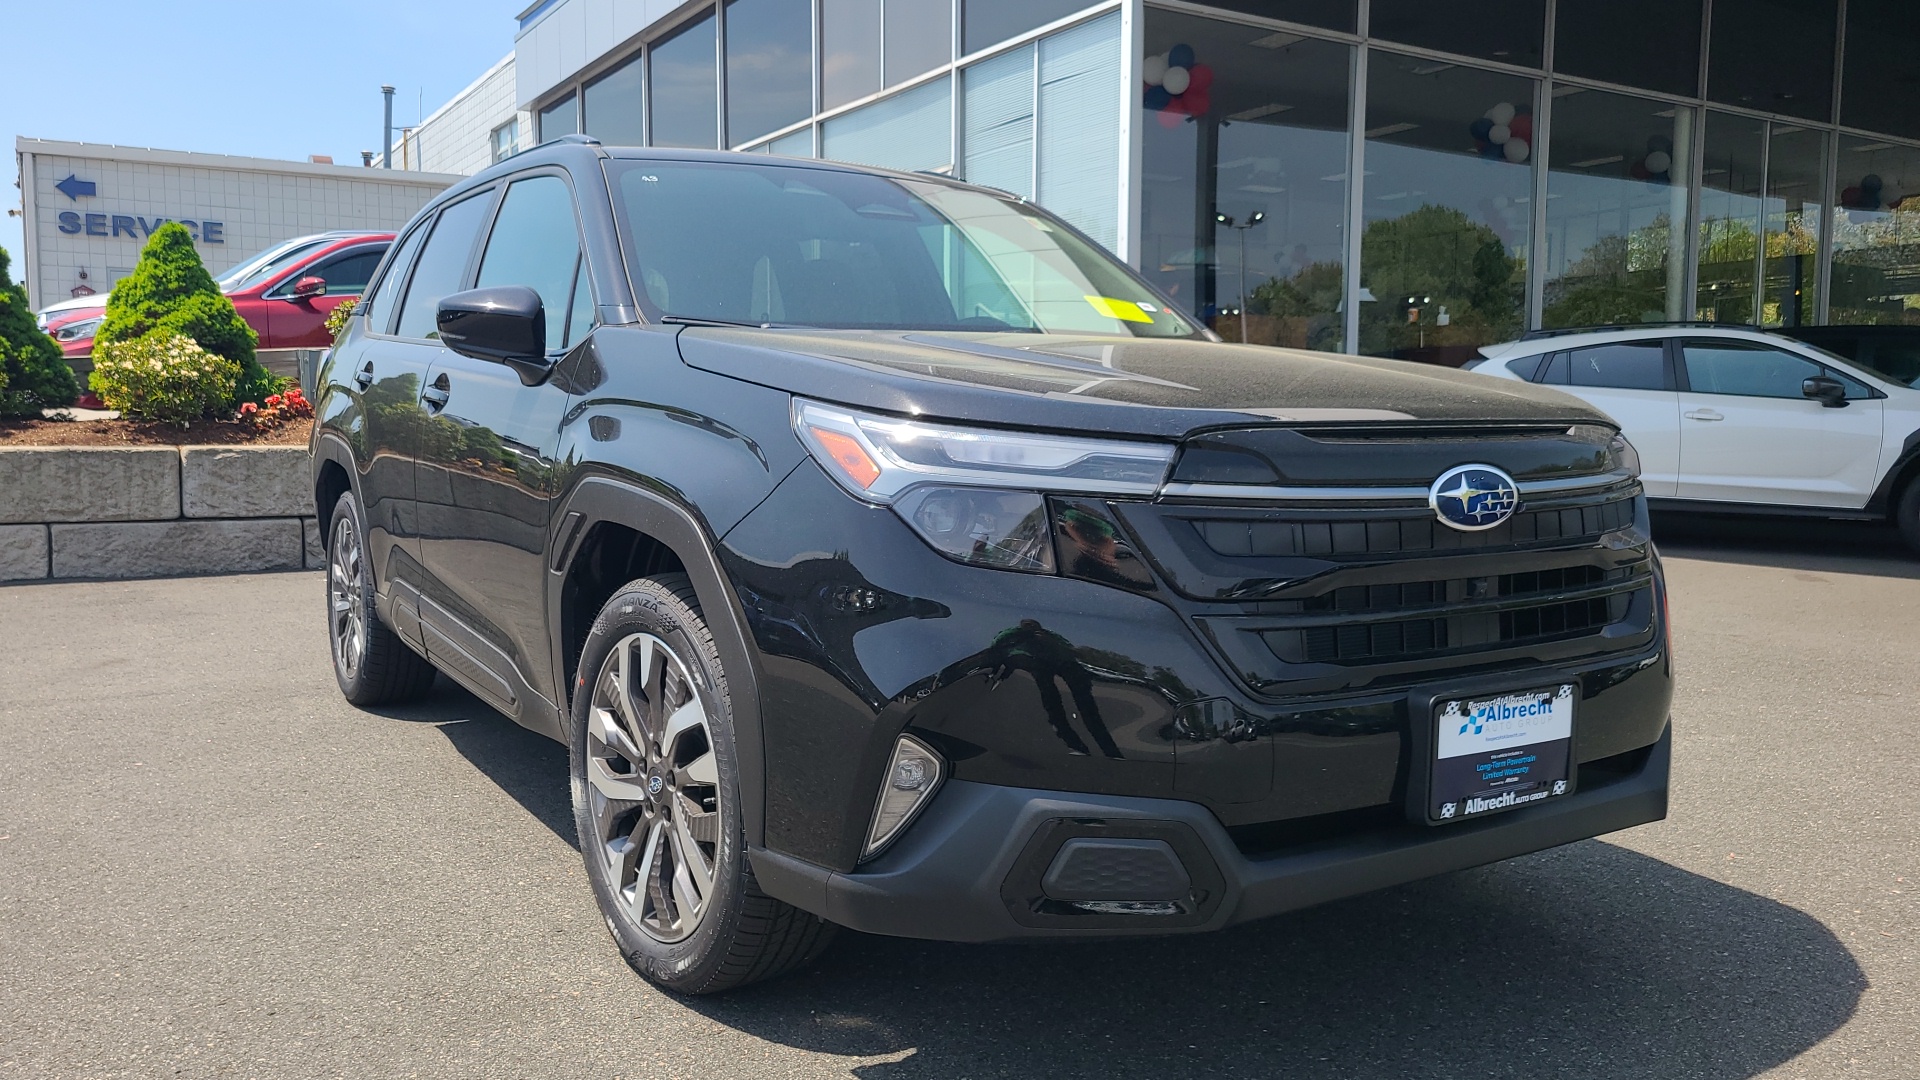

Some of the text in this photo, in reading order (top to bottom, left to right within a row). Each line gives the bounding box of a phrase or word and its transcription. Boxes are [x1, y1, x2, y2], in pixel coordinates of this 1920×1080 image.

[58, 211, 224, 244] SERVCE
[1485, 699, 1553, 722] Albrecht
[1485, 715, 1553, 733] AUTO GROUP
[1482, 769, 1504, 780] Limited
[1504, 766, 1529, 776] Warranty
[1464, 791, 1515, 814] Albrecht
